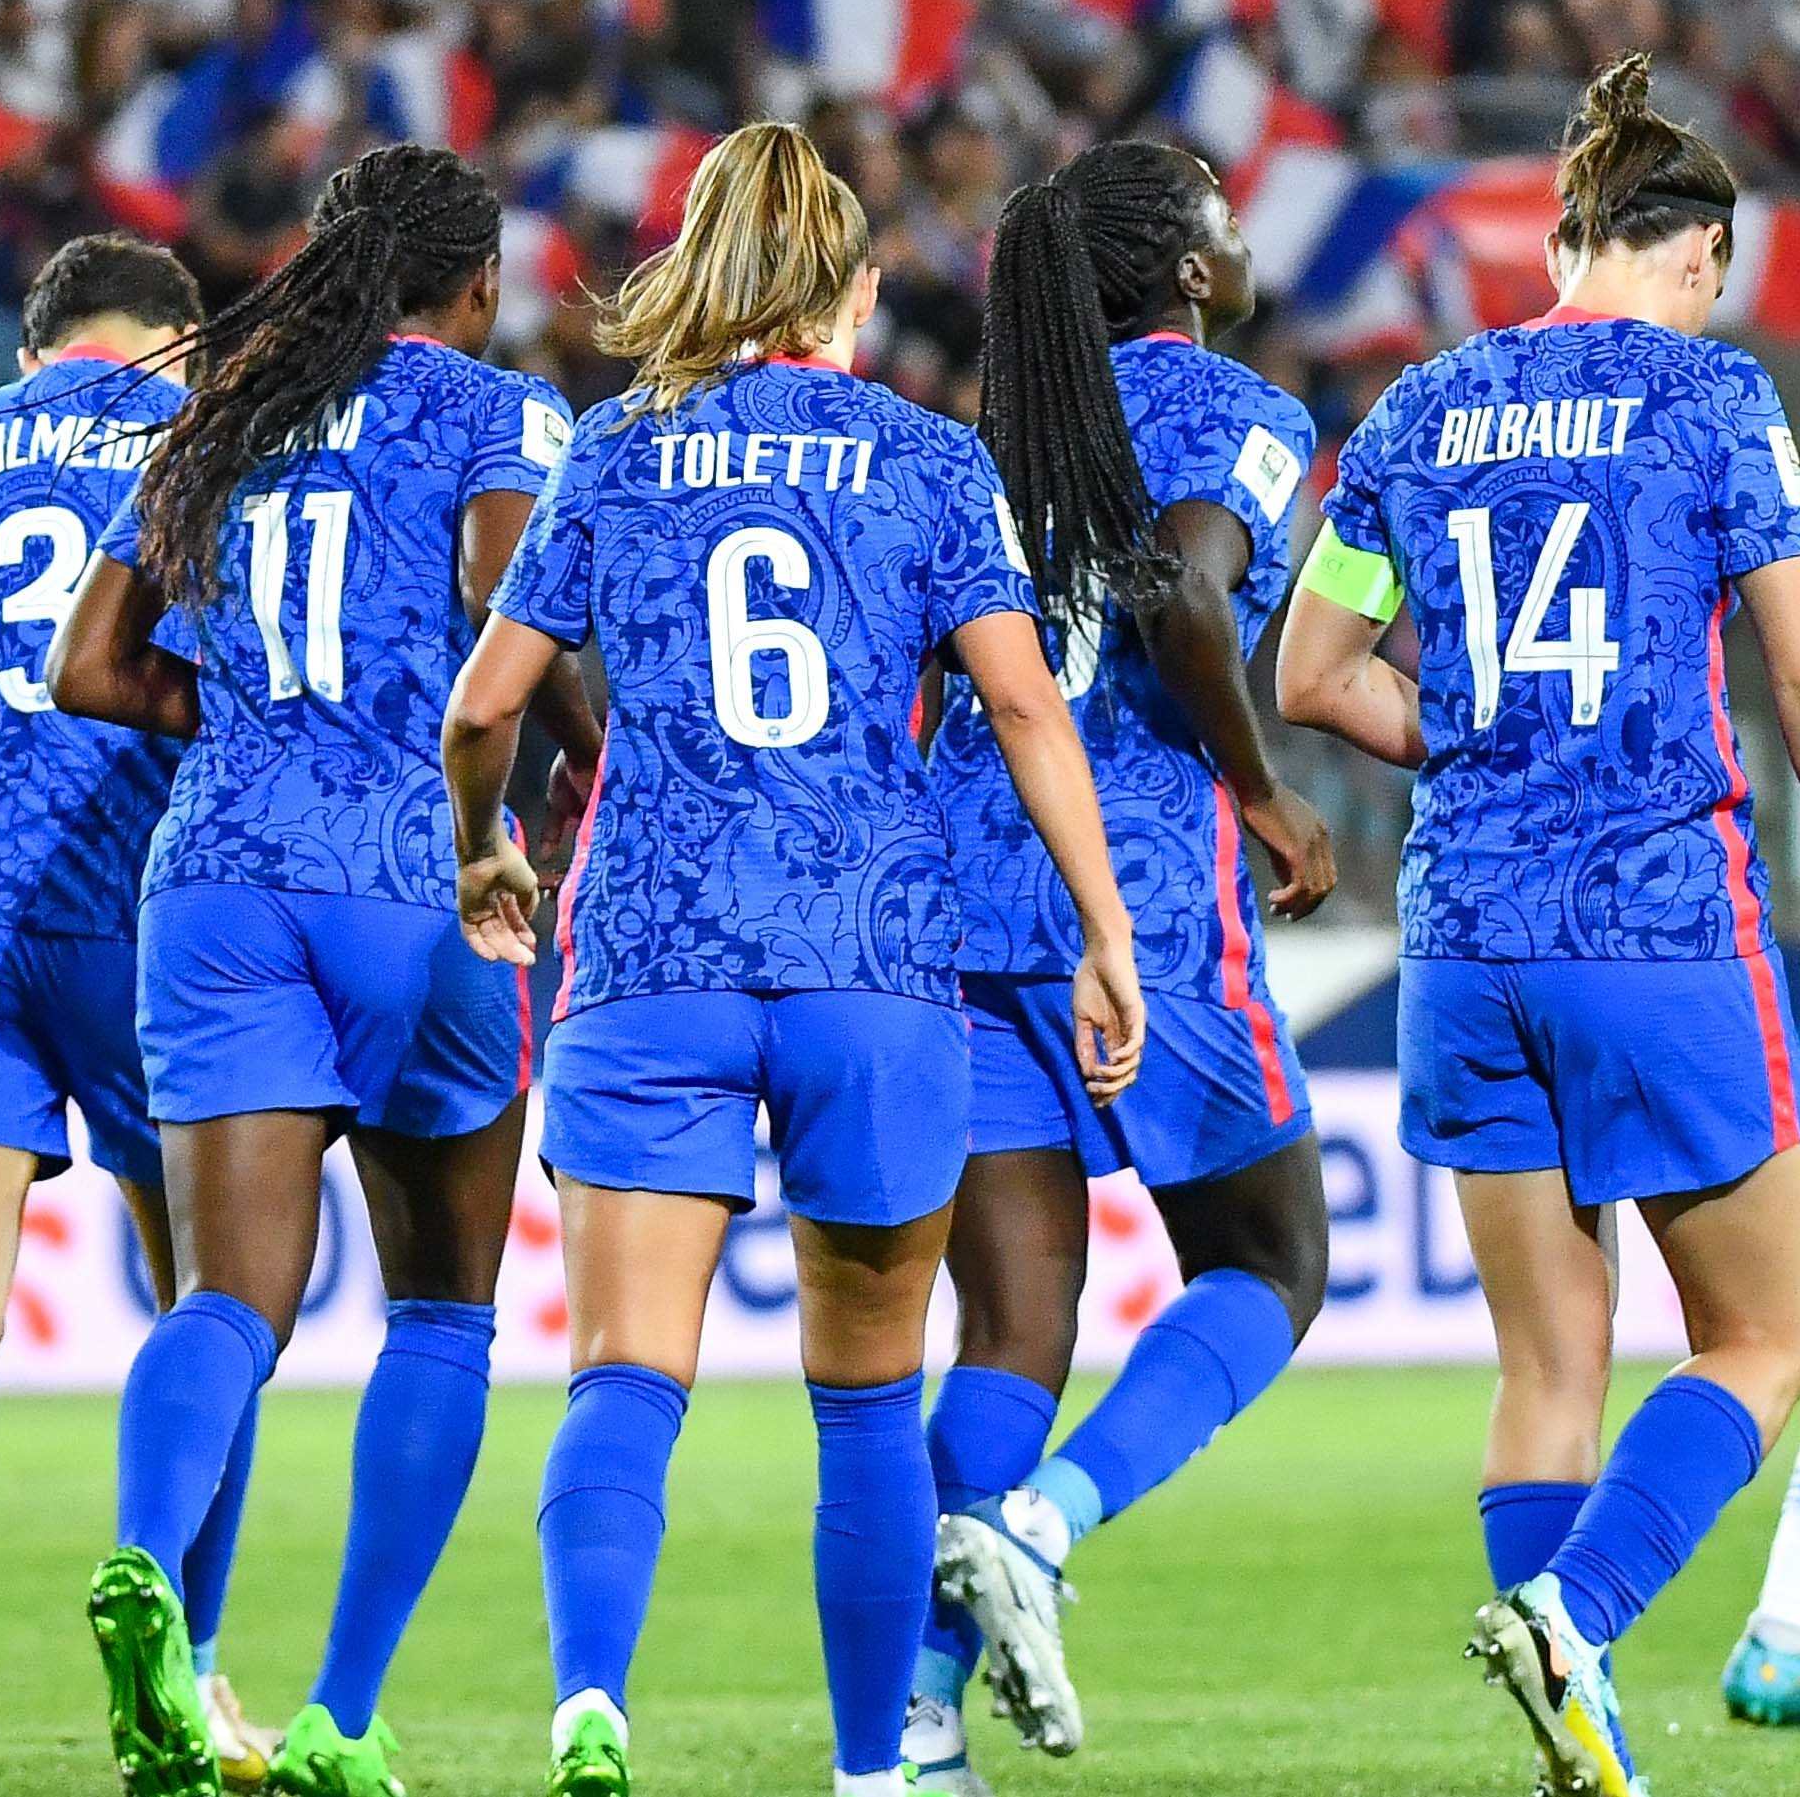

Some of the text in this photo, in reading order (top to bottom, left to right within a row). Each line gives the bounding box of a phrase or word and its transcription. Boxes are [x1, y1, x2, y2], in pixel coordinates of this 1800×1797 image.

[651, 430, 873, 494] TOLETTI
[1435, 397, 1643, 468] BILBAULT
[242, 490, 353, 703] 11
[706, 527, 830, 748] 6
[1447, 502, 1620, 730] 14
